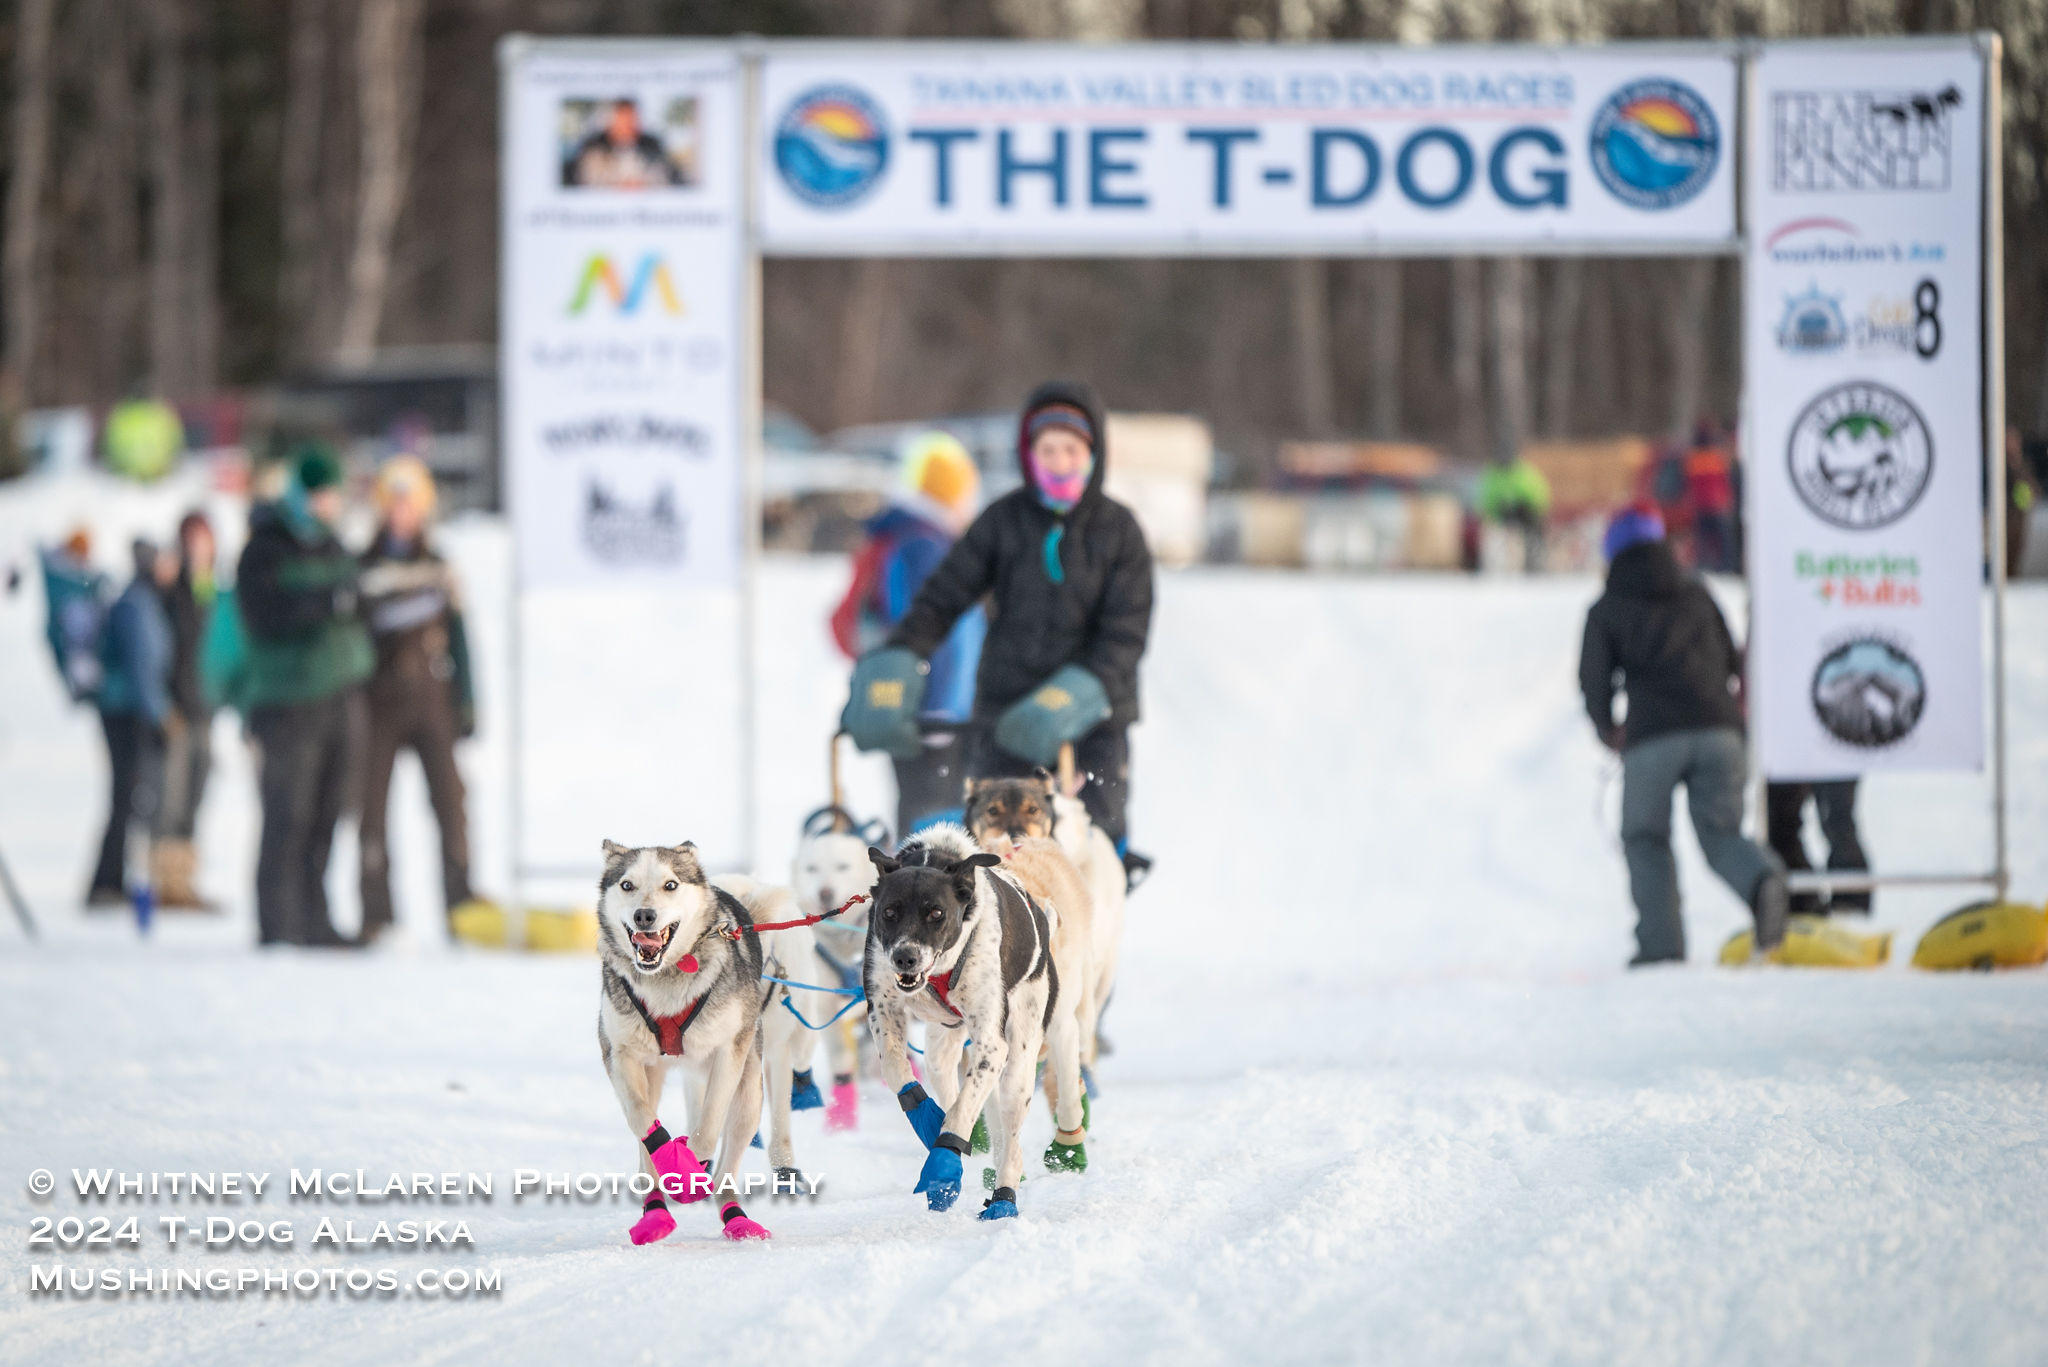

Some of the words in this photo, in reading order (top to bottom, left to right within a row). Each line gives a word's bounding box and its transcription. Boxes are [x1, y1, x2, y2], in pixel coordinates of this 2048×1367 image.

[1086, 73, 1232, 106] VALLEY
[1349, 73, 1435, 106] DOG
[908, 128, 1148, 209] THE
[1186, 126, 1570, 211] T-DOG
[1914, 278, 1942, 360] 8
